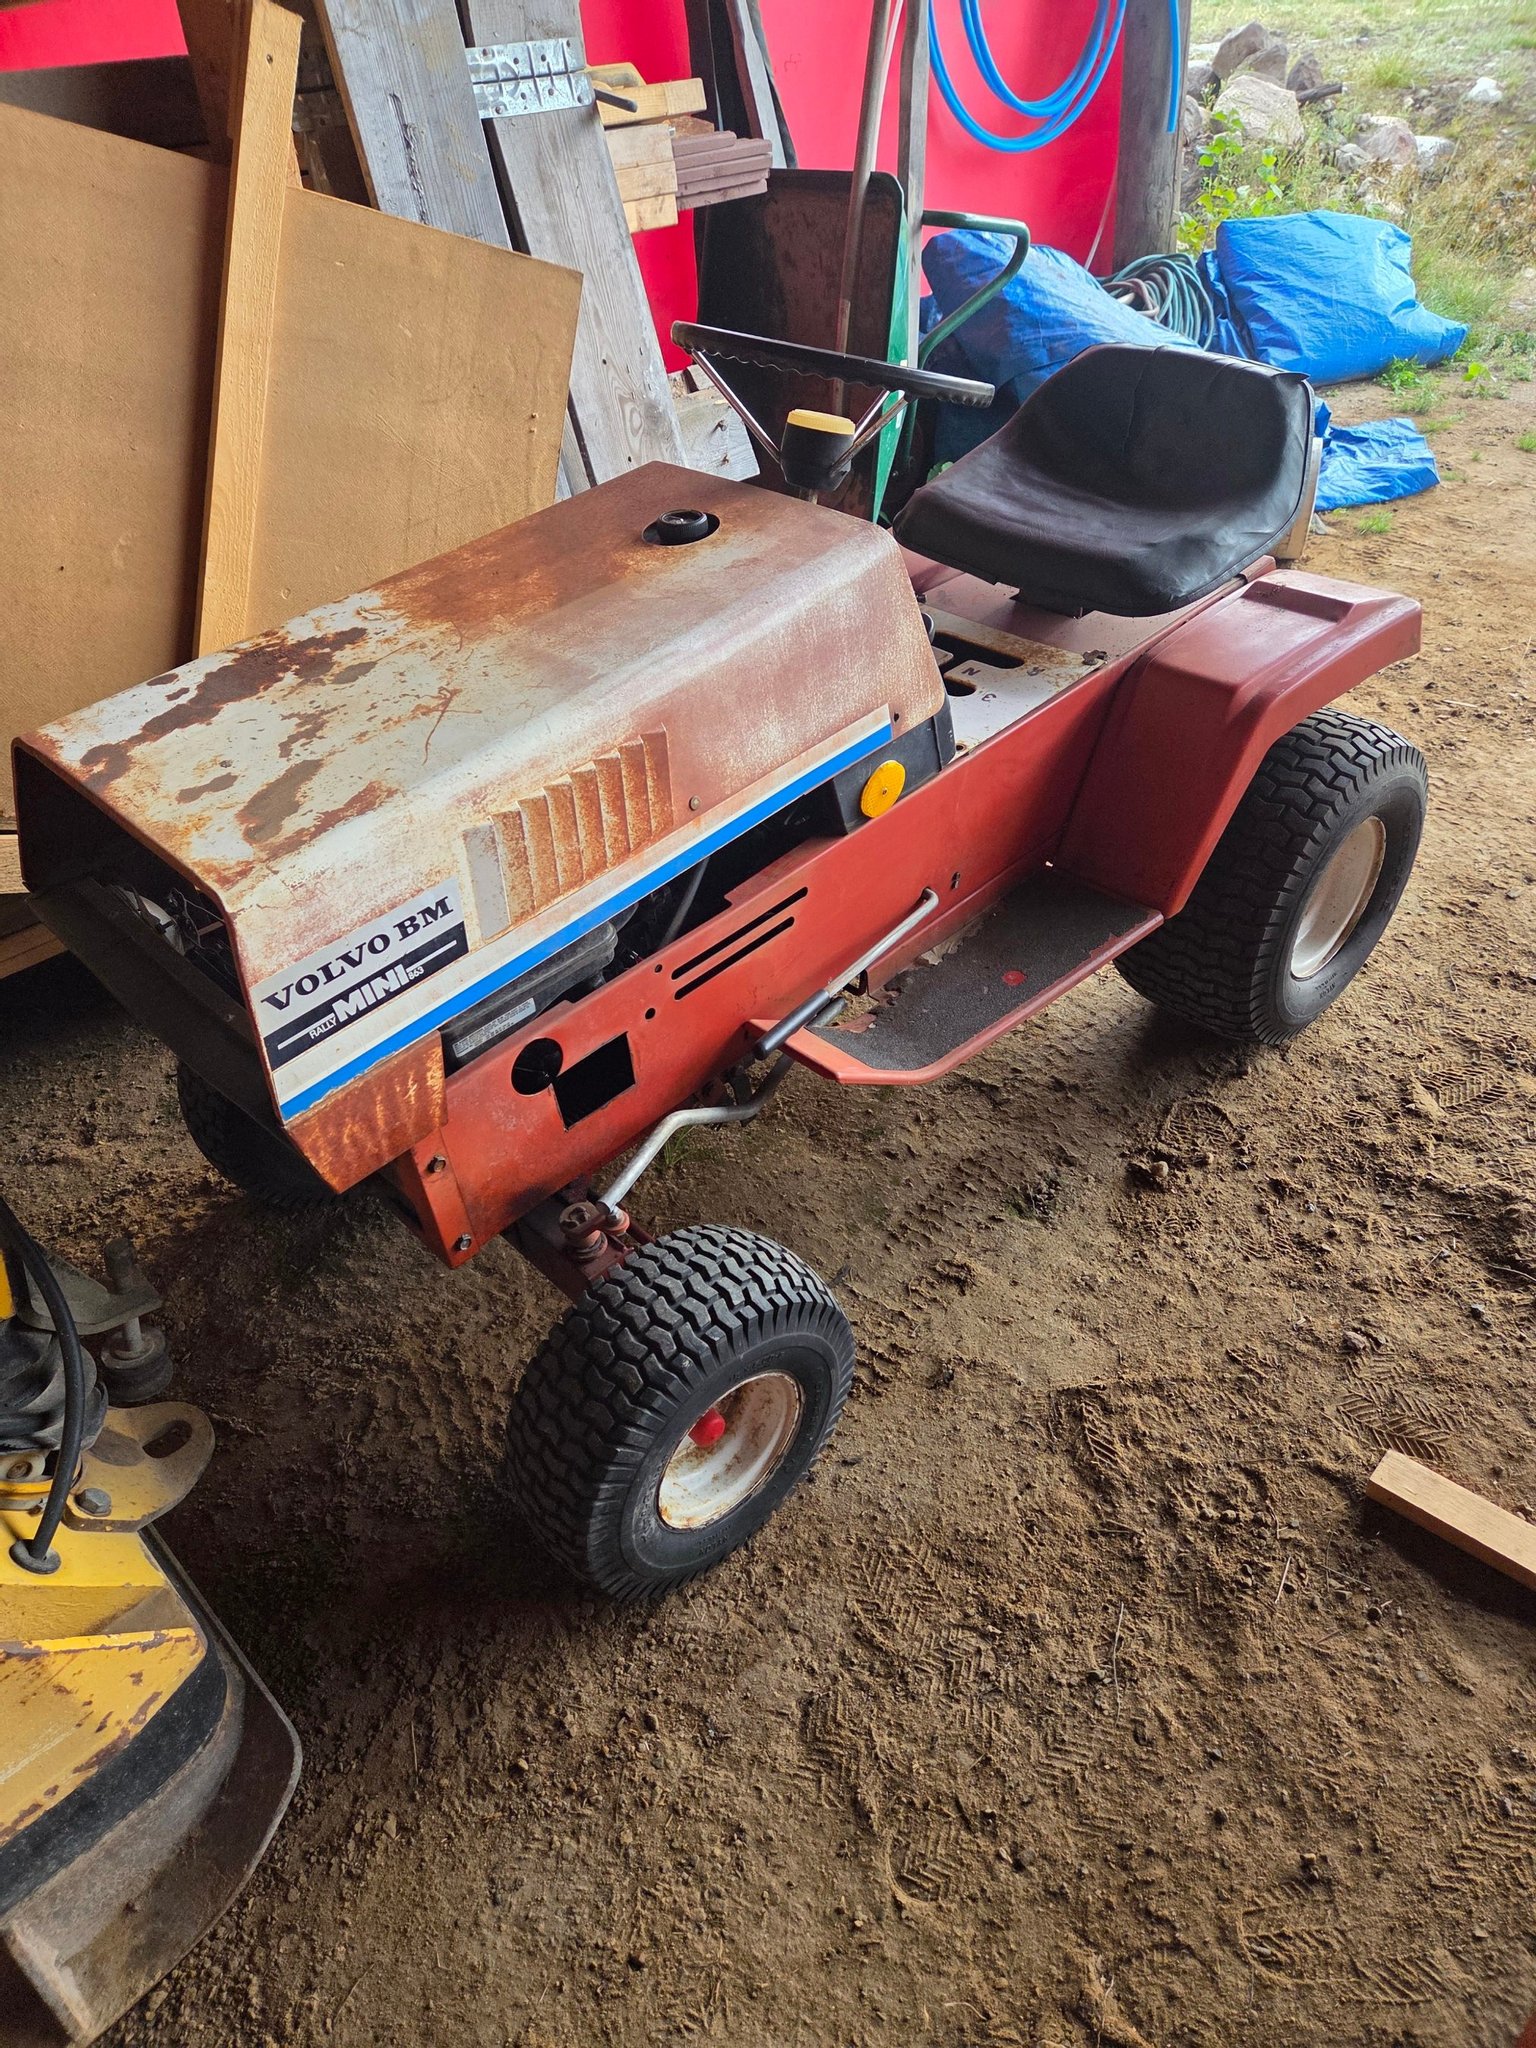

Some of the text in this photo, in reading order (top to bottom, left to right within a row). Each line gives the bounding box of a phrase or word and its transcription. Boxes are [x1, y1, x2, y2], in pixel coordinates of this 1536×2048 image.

[961, 667, 981, 676] N
[260, 895, 454, 1011] VOLVO BM
[308, 1016, 338, 1040] RALLY
[331, 963, 410, 1023] MINI
